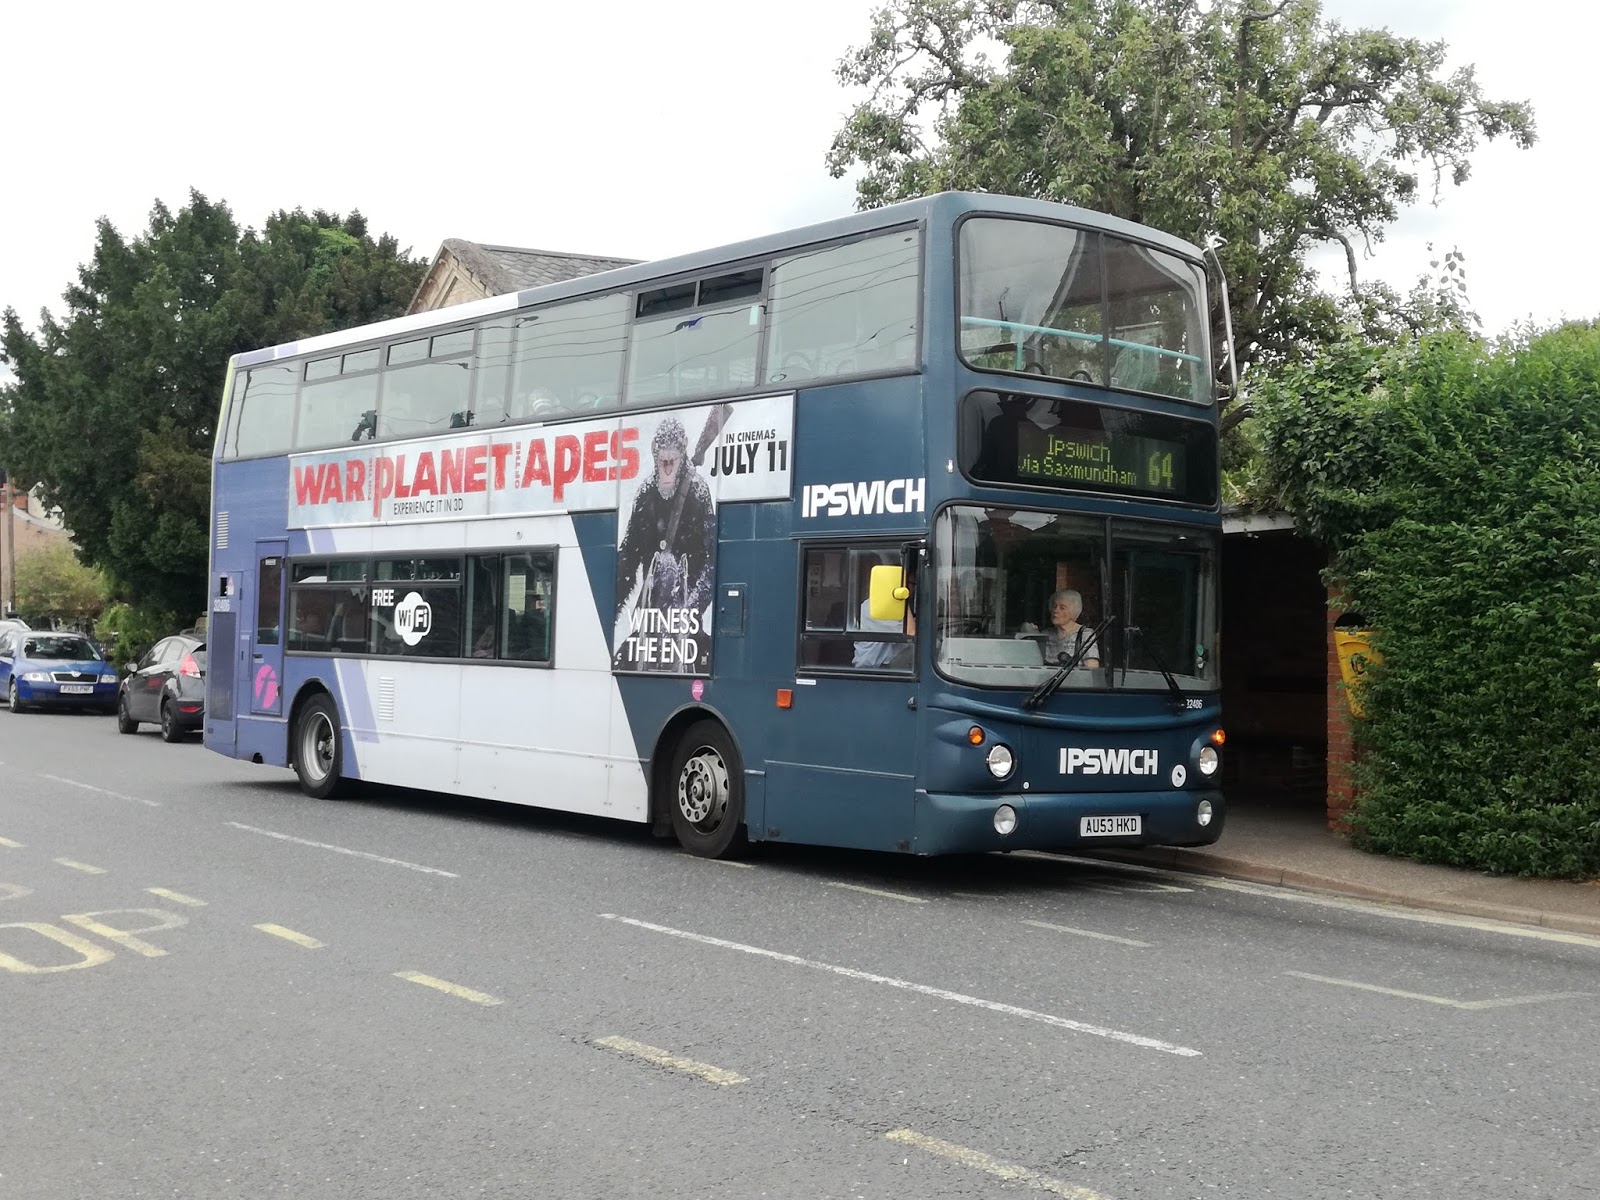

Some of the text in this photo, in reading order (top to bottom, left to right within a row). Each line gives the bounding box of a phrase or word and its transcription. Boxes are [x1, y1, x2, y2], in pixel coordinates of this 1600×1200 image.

[725, 428, 776, 443] IN CINEMAS
[1047, 434, 1111, 463] Ipswich
[294, 459, 365, 506] WAR
[373, 443, 513, 518] PLANET
[521, 426, 640, 503] APES
[710, 440, 787, 477] JULY 11
[1018, 454, 1137, 486] via Saxmundham
[1148, 451, 1174, 488] 64
[393, 498, 464, 515] EXPERIENCE IT IN 3D
[802, 477, 926, 518] IPSWICH
[371, 589, 395, 606] FREE
[627, 607, 700, 634] WITNESS
[626, 637, 698, 664] THE END
[1059, 747, 1159, 775] IPSWICH
[1086, 818, 1137, 834] AU53 HKD
